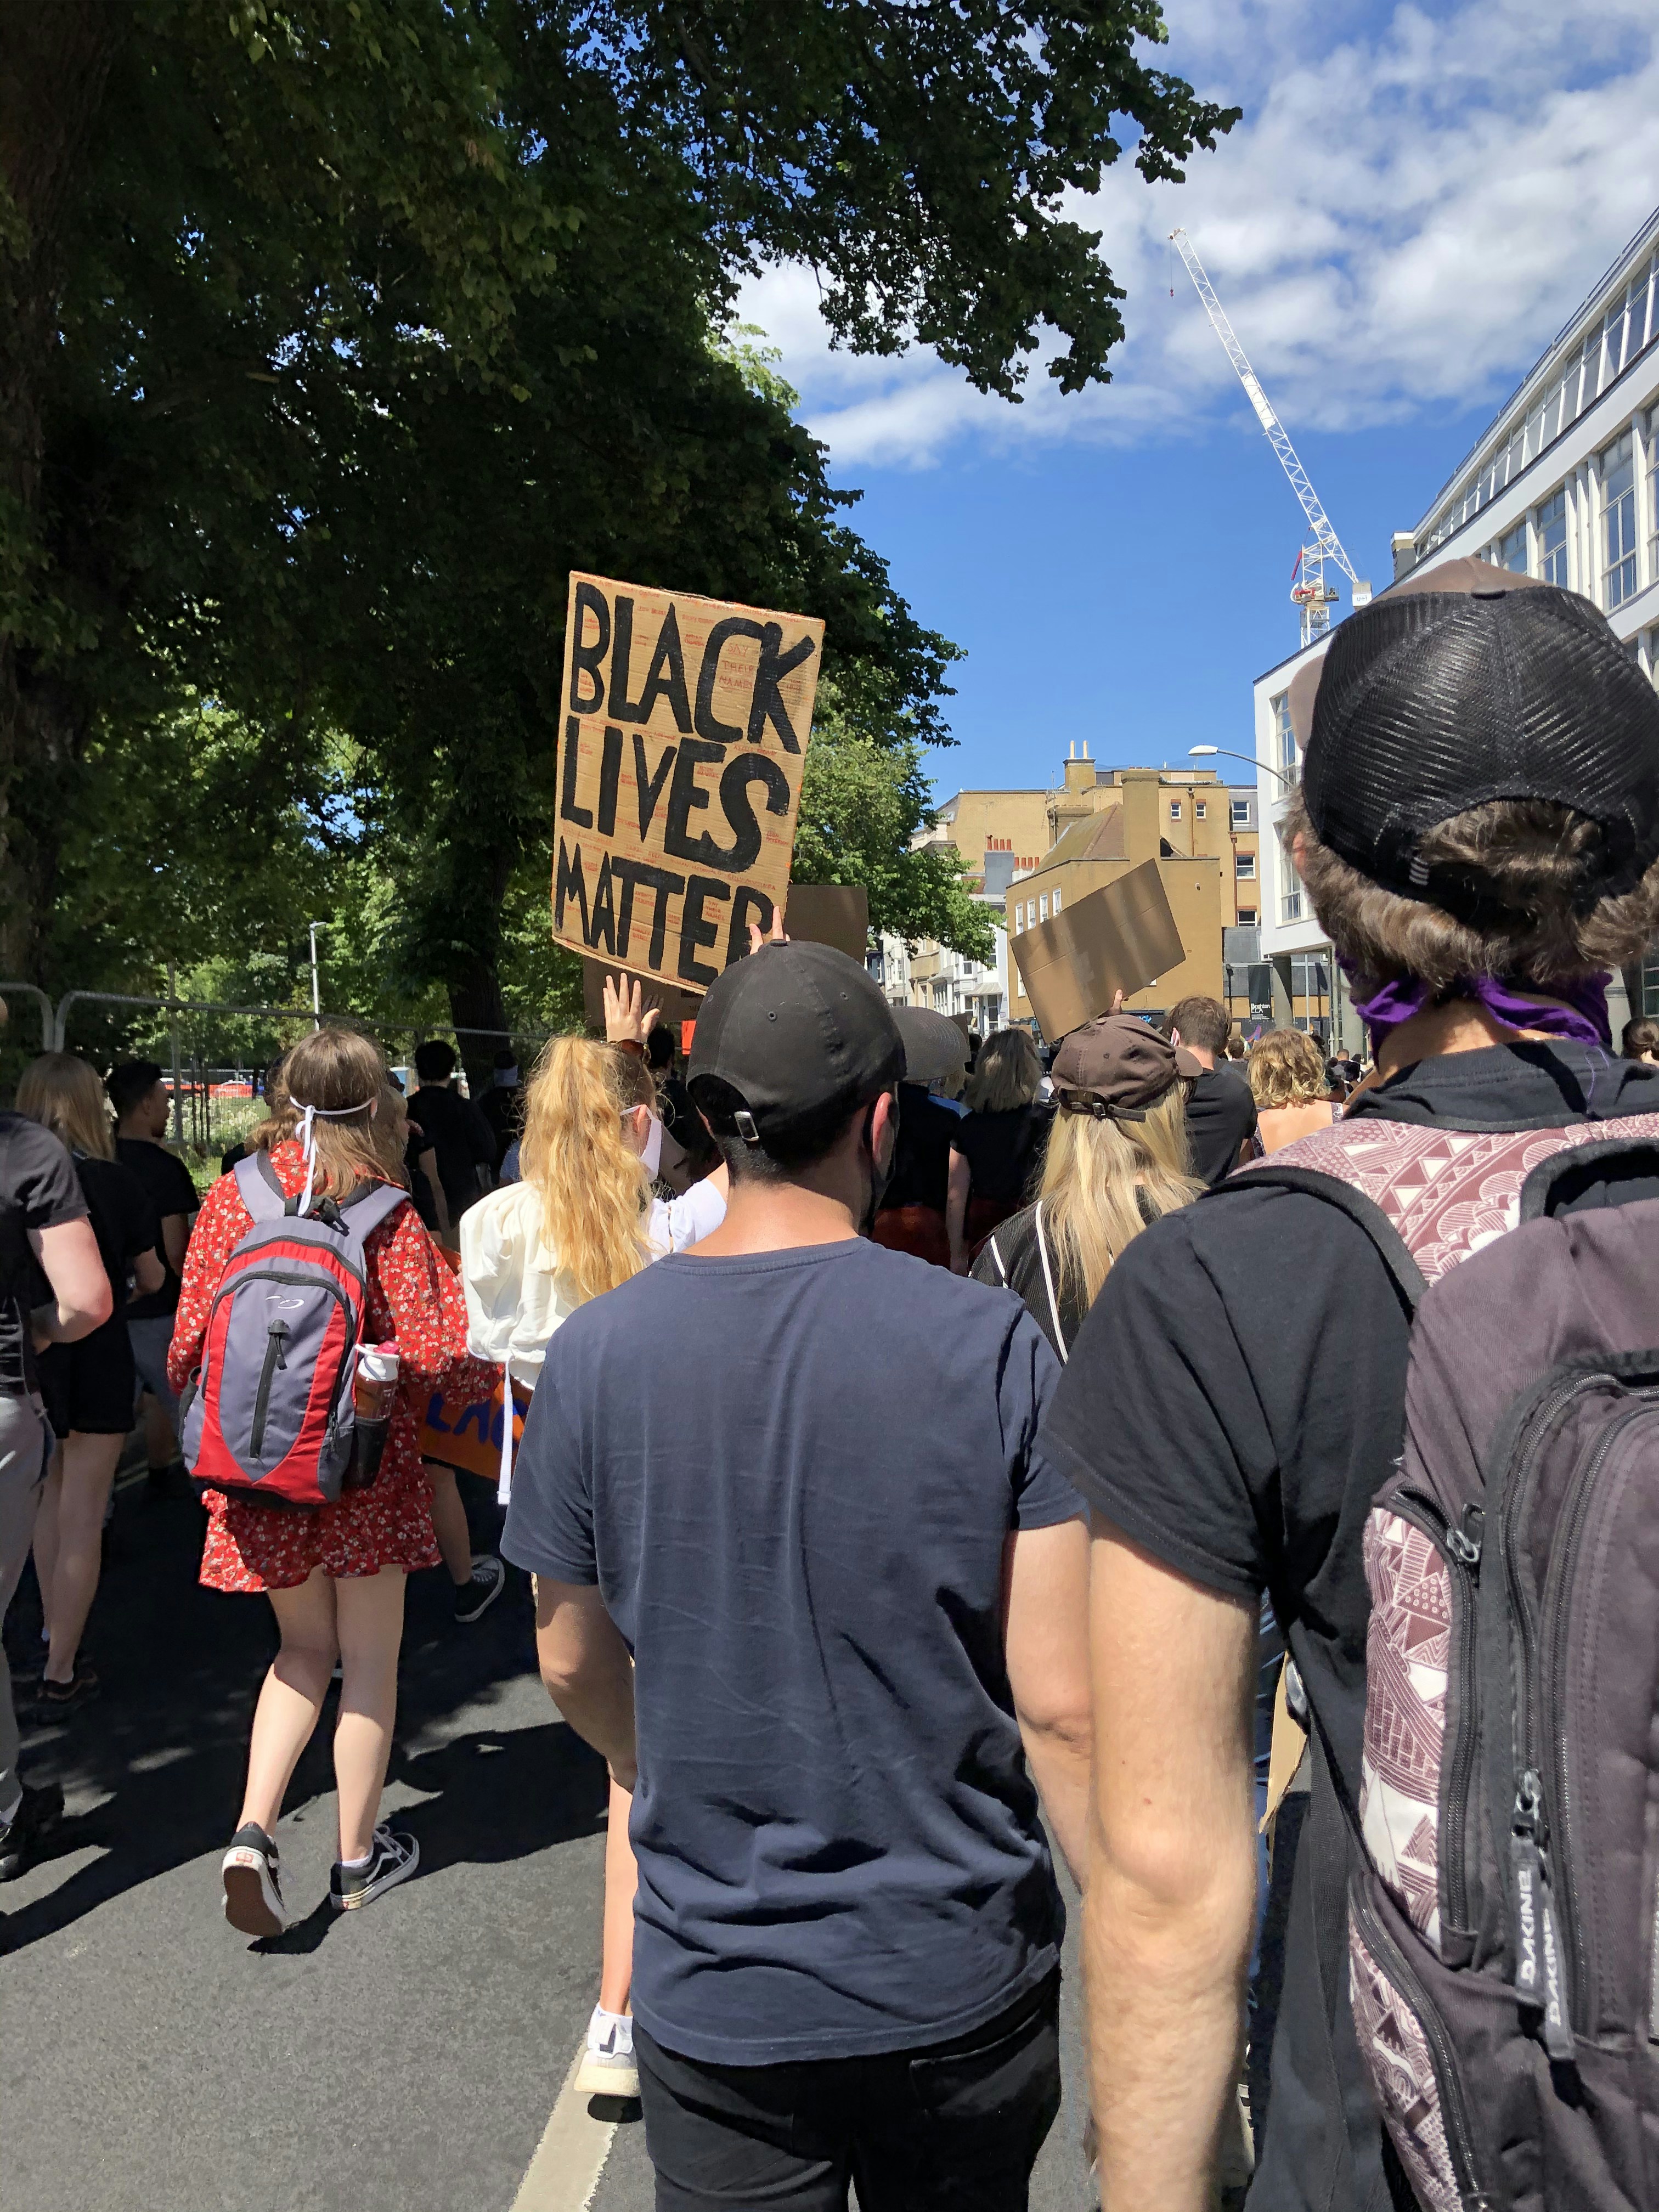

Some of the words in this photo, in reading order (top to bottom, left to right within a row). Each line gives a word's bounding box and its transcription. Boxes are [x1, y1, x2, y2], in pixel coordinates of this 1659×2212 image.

[569, 582, 815, 754] BLACK
[719, 676, 753, 689] NAMES
[721, 660, 755, 673] THEIR
[728, 643, 748, 655] SAY
[561, 715, 790, 873] LIVES
[555, 836, 774, 985] MATTER
[1518, 1869, 1535, 1985] DAKINE
[1542, 1907, 1562, 2027] DAKINE
